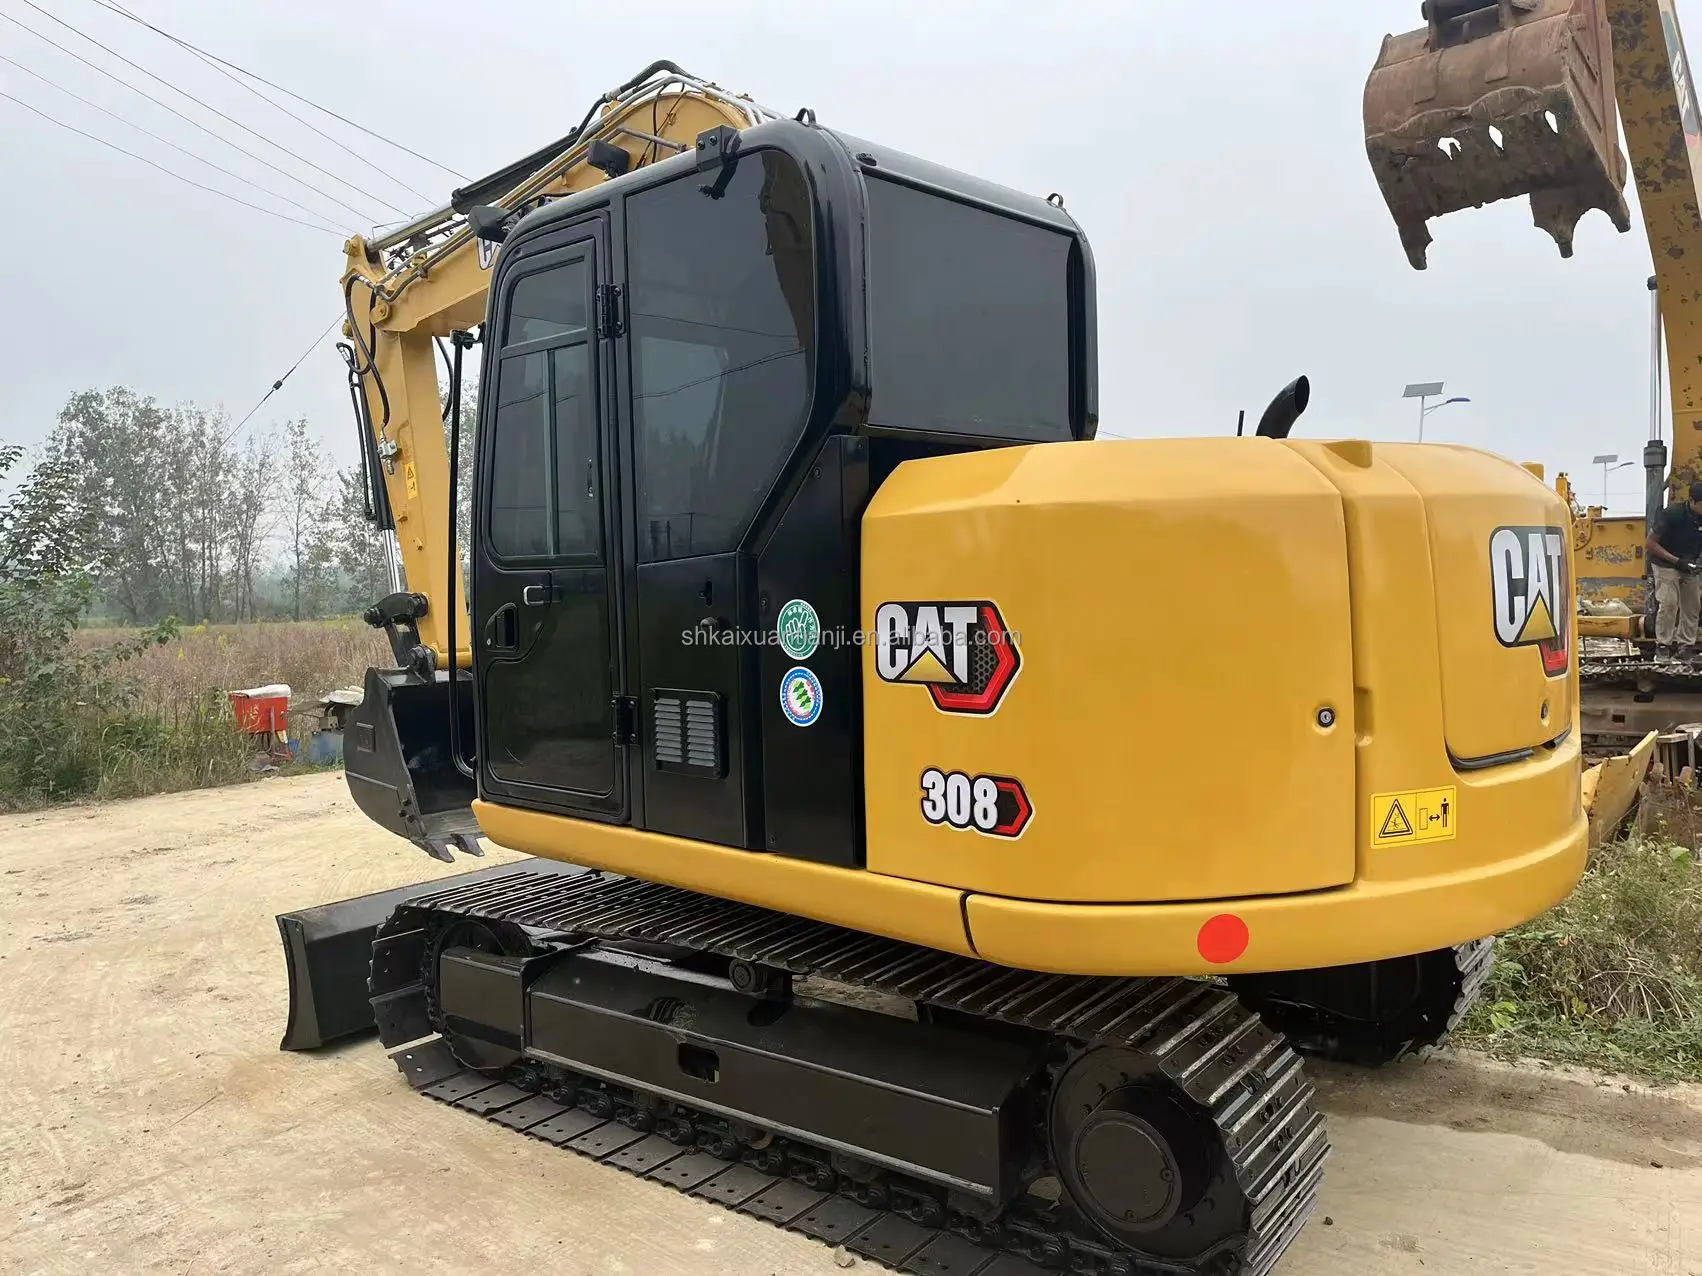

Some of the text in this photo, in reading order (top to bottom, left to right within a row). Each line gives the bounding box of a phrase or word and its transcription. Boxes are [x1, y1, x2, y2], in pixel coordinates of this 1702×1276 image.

[1491, 529, 1562, 643] CAT
[877, 603, 978, 684] CAT
[922, 770, 998, 829] 308
